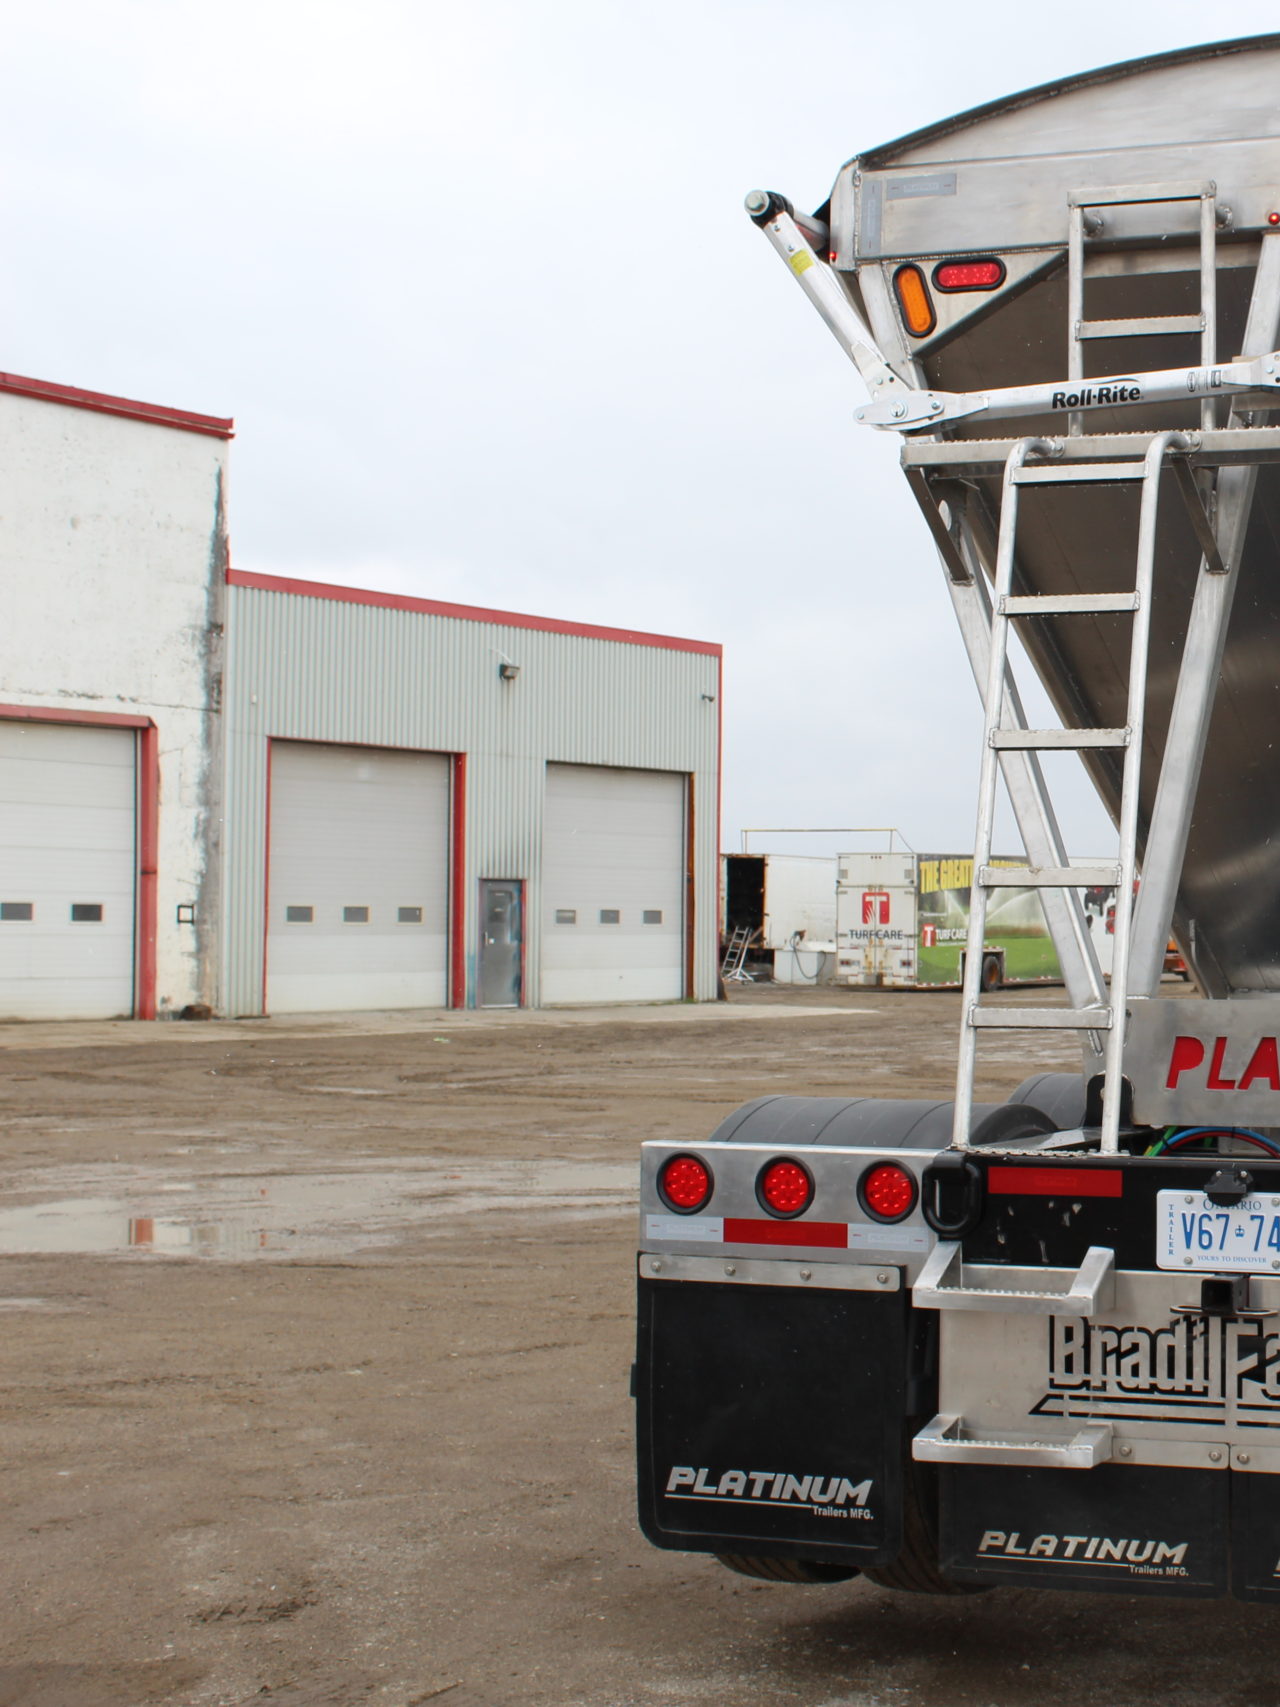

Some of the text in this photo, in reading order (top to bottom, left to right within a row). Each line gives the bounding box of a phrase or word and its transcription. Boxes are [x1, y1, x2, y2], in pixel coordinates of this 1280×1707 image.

[919, 860, 940, 894] THE
[1181, 1213, 1230, 1250] V67
[1232, 1256, 1267, 1264] DISCOVER
[666, 1466, 873, 1506] PLATINUM
[813, 1505, 874, 1520] Trailers MFG.
[978, 1530, 1189, 1564] PLATINUM
[1129, 1564, 1189, 1577] Trailers MFG.
